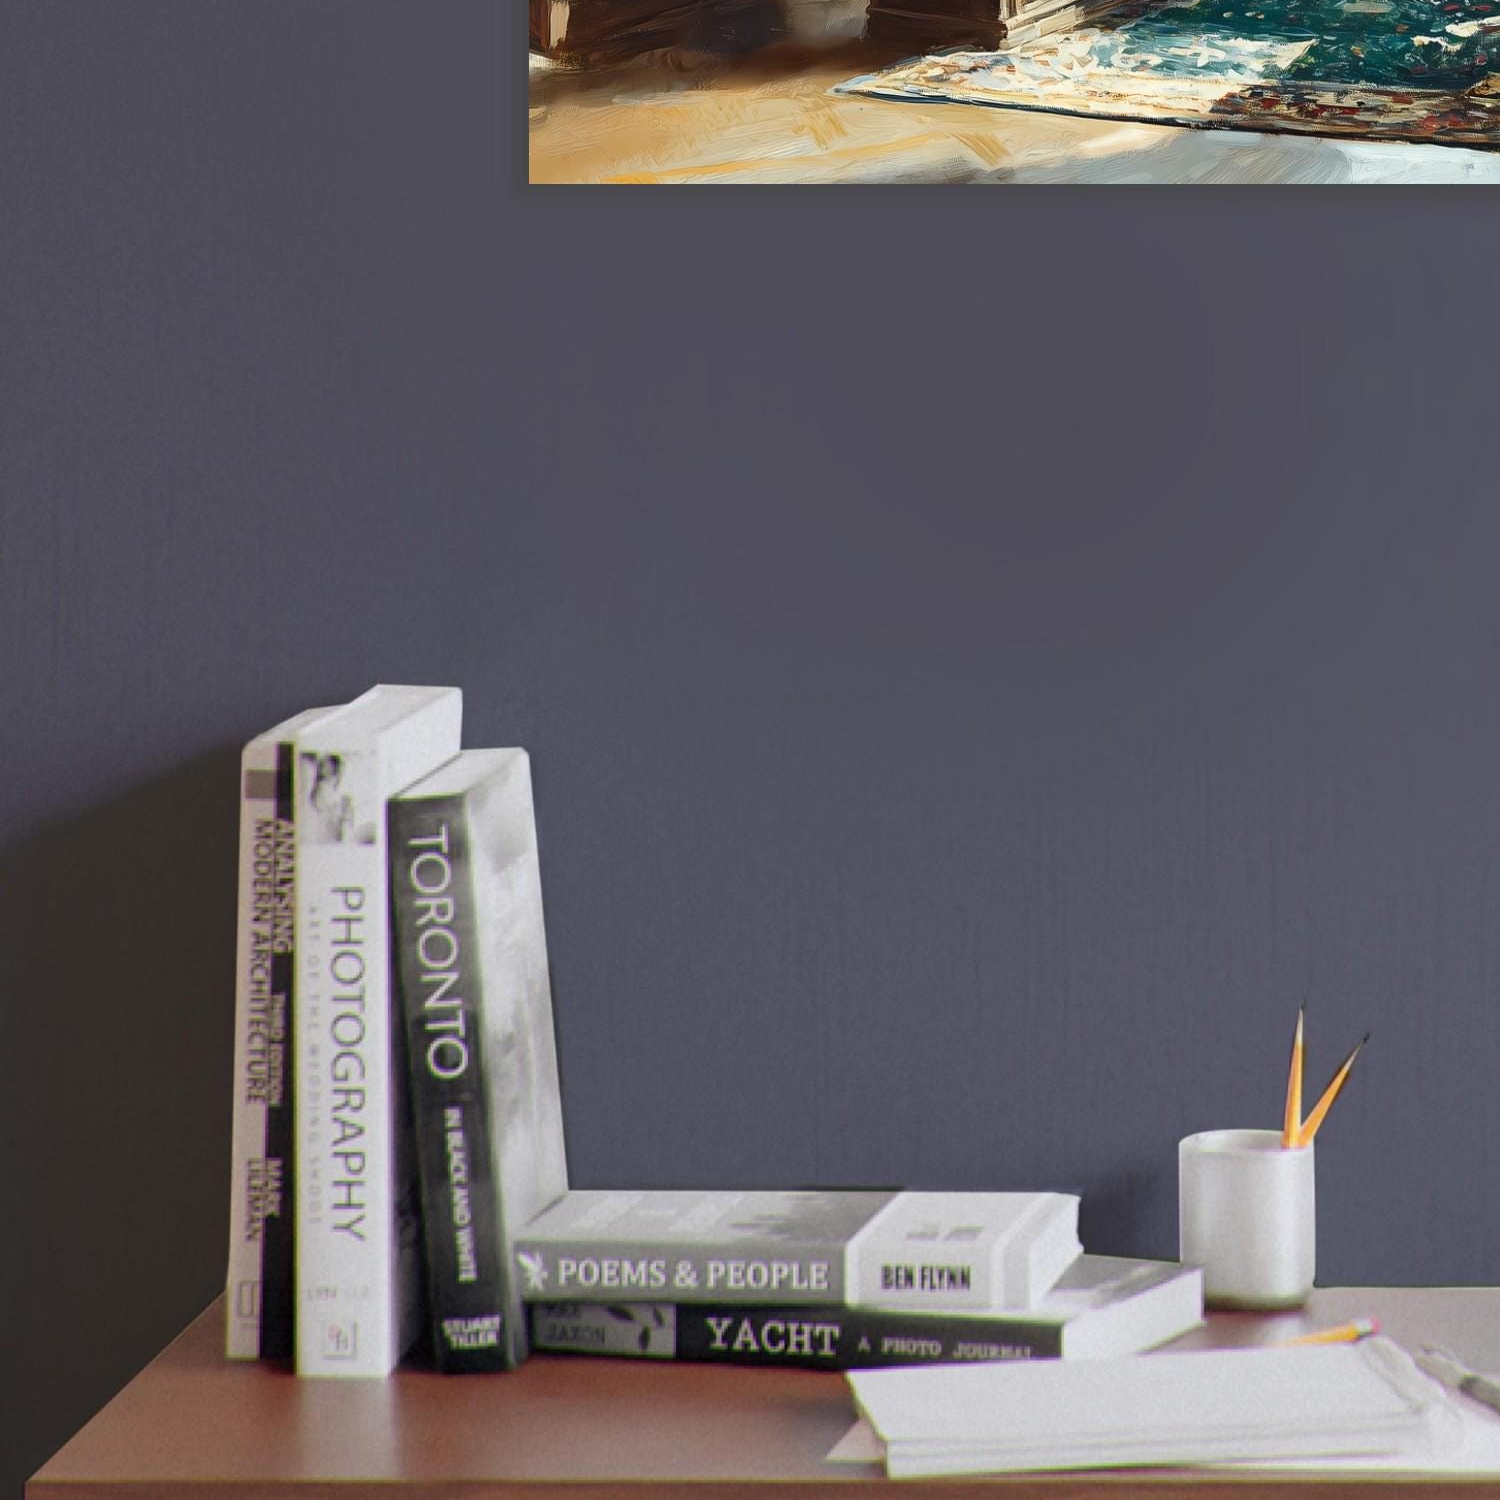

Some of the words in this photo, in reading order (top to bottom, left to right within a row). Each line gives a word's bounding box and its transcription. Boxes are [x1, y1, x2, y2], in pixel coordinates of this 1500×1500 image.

[252, 819, 272, 921] MODERN
[408, 824, 468, 1078] TORONTO
[246, 931, 270, 1104] ARCHITECTURE
[331, 886, 366, 1241] PHOTOGRAPHY
[558, 1258, 667, 1288] POEMS
[674, 1259, 699, 1288] &
[706, 1260, 829, 1290] PEOPLE
[881, 1265, 914, 1290] BEN
[920, 1265, 971, 1290] FLYNN
[706, 1316, 840, 1357] YACHT
[858, 1336, 871, 1352] A
[882, 1337, 942, 1356] PHOTO
